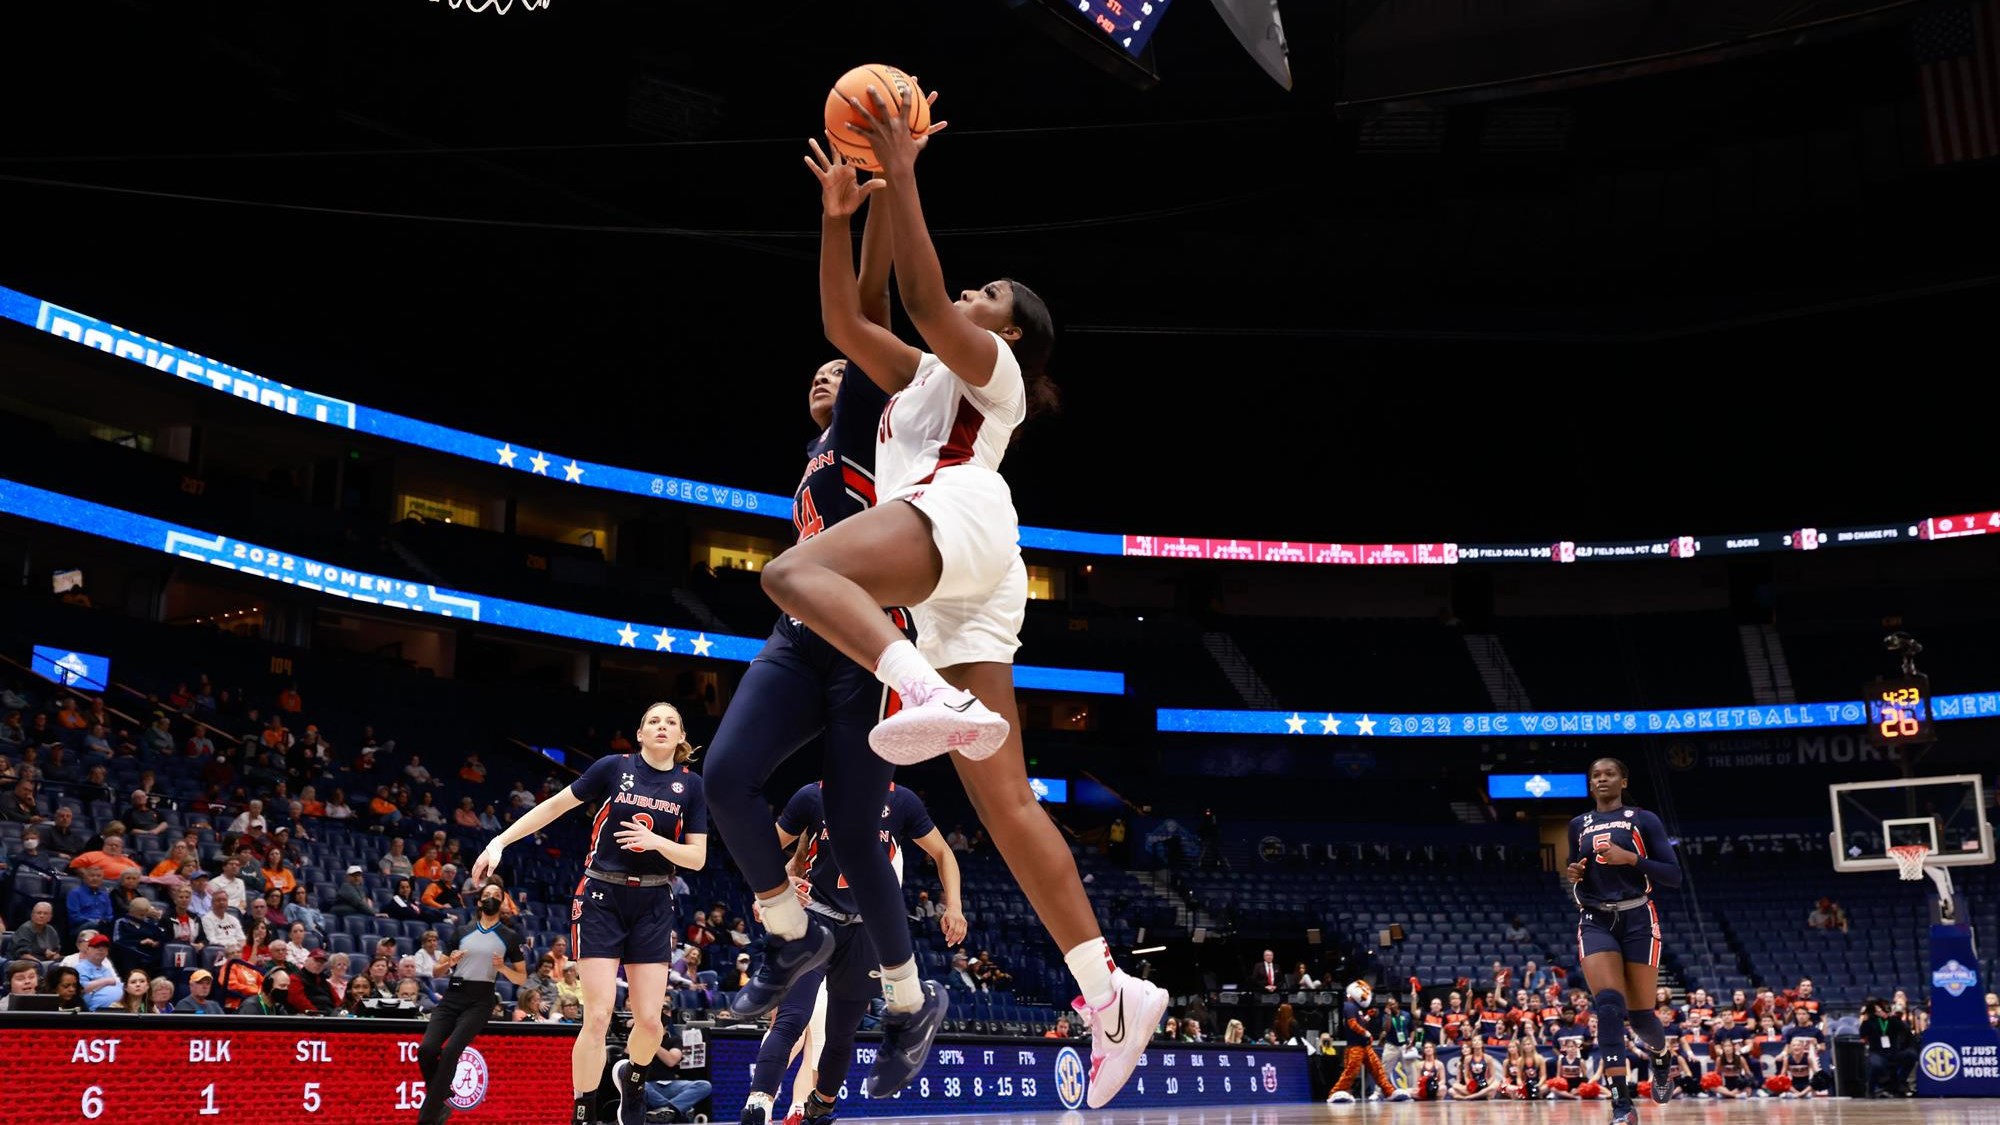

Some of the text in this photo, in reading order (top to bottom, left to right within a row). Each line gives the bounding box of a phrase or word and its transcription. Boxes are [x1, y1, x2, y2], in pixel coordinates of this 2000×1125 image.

[651, 478, 758, 510] #SECWBB
[1594, 547, 1614, 556] FIELD
[1615, 547, 1635, 555] GOAL
[1727, 538, 1759, 548] BLOCKS
[1480, 549, 1502, 557] FIELD
[1503, 549, 1529, 557] GOALS
[233, 543, 294, 571] 2022
[305, 562, 418, 598] WOMEN'S
[1882, 688, 1919, 706] 4:23
[1389, 716, 1450, 733] 2022
[1463, 716, 1509, 732] SEC
[1521, 713, 1636, 732] WOMEN'S
[1650, 707, 1814, 730] BASKETBALL
[1881, 708, 1918, 737] 26
[1735, 752, 1774, 767] HOME
[614, 792, 681, 815] AUBURN
[1582, 820, 1632, 835] AUBURN
[72, 1039, 120, 1063] AST
[189, 1040, 231, 1063] BLK
[295, 1040, 332, 1063] STL
[939, 1050, 964, 1065] 3PT%
[984, 1051, 994, 1065] FT
[1019, 1051, 1036, 1065] FT%
[1961, 1046, 1998, 1056] IT JUST
[1138, 1054, 1255, 1067] EB AST BLK STL TO
[1925, 1046, 1955, 1077] SEC
[1962, 1056, 1998, 1066] MEANS
[920, 1077, 930, 1098] 8
[944, 1077, 961, 1097] 38
[974, 1077, 983, 1097] 8
[998, 1077, 1013, 1097] 15
[1021, 1078, 1037, 1097] 53
[1166, 1077, 1178, 1094] 10
[1197, 1077, 1204, 1093] 3
[1224, 1077, 1231, 1093] 6
[1251, 1076, 1258, 1092] 8
[81, 1086, 104, 1119] 6
[199, 1083, 219, 1115] 1
[303, 1082, 321, 1112] 5
[394, 1081, 426, 1110] 15
